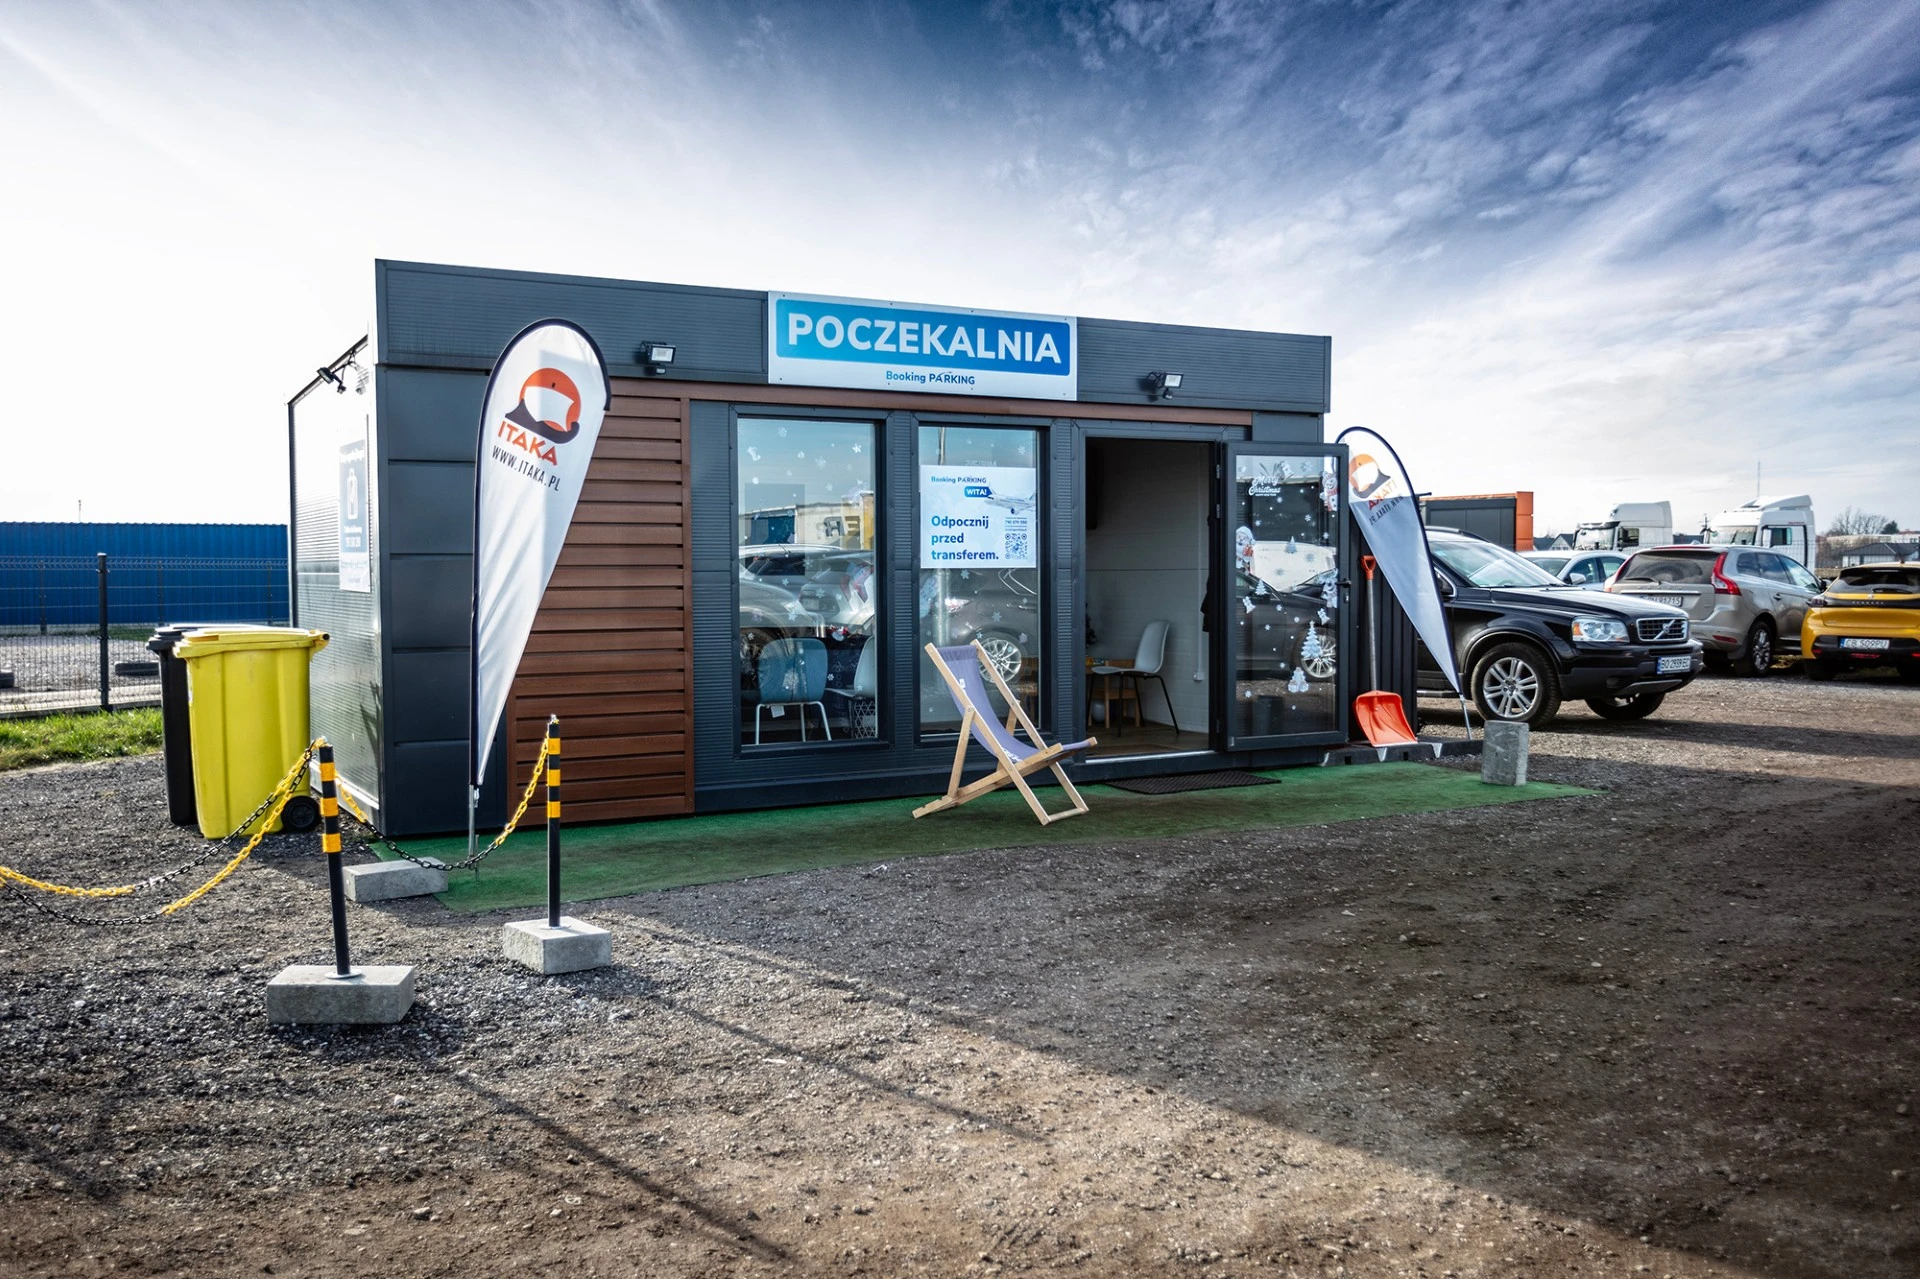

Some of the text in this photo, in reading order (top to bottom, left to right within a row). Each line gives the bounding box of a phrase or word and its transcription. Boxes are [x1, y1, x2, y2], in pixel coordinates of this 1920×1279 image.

[788, 312, 1062, 364] POCZEKALNIA
[886, 370, 975, 385] Booking PARKING
[497, 420, 558, 466] ITAKA
[492, 445, 561, 492] WWW.ITAKA.PL
[966, 488, 988, 496] WITA!
[931, 515, 990, 529] Odpocznij
[931, 532, 964, 545] przed
[931, 549, 999, 560] transferem.
